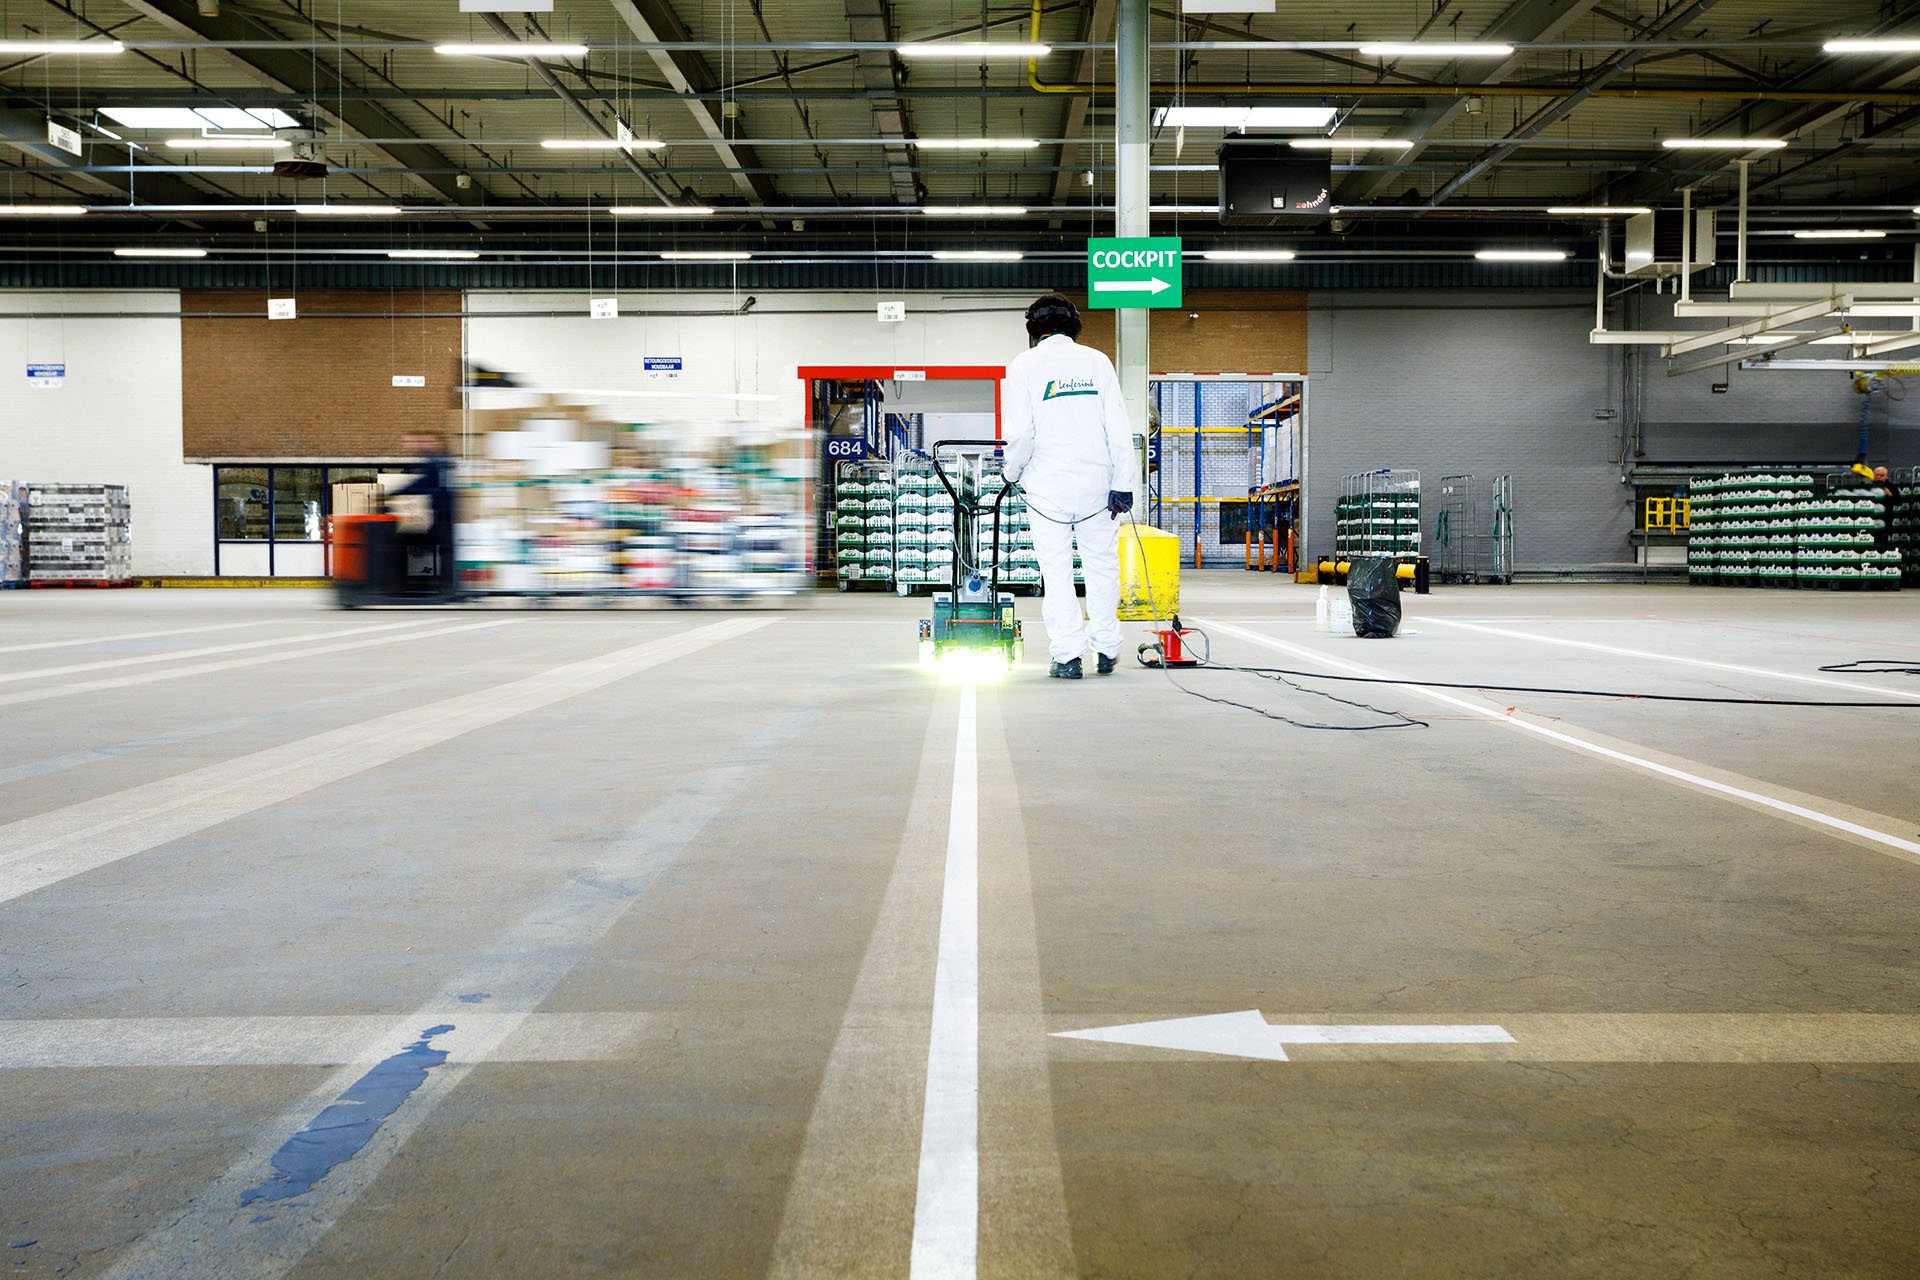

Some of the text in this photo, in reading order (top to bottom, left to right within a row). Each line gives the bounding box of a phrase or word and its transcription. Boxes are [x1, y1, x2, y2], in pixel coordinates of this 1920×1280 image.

[1296, 187, 1328, 209] zehnder
[1093, 251, 1178, 268] COCKPIT
[1058, 378, 1095, 393] Lenferink
[828, 441, 863, 456] 684
